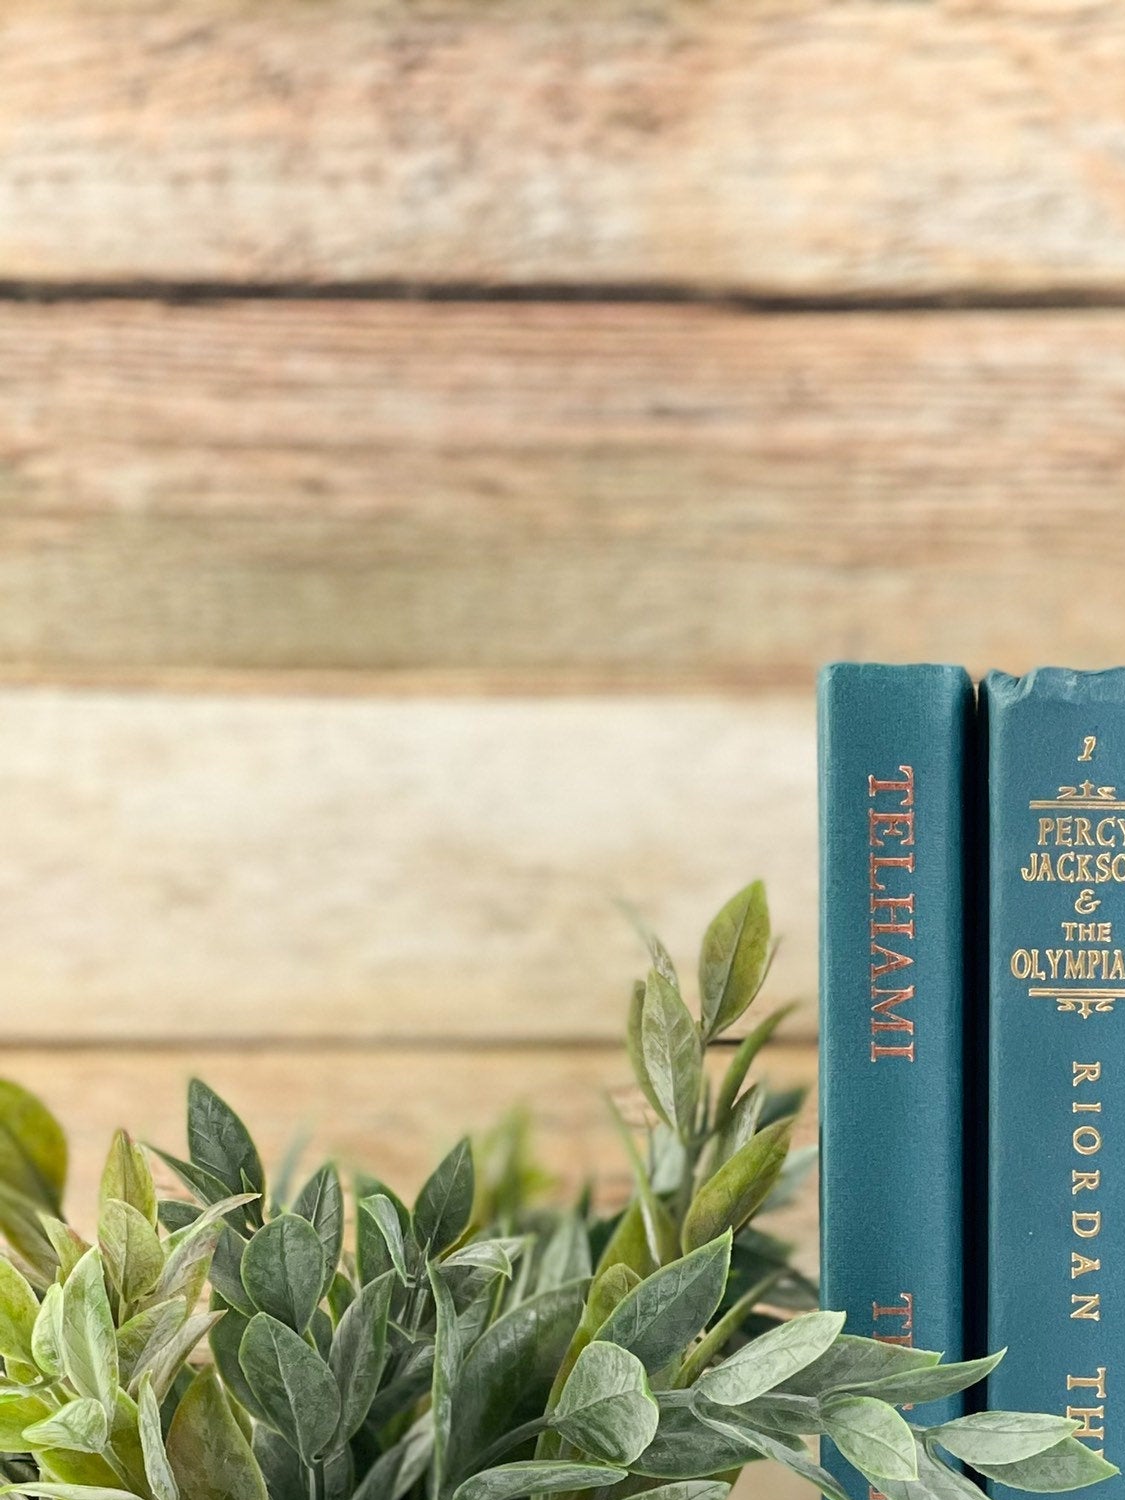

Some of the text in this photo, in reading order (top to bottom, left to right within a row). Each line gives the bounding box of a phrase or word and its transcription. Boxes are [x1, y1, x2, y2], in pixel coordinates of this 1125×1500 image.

[868, 765, 915, 1062] TELHAMI
[1062, 922, 1111, 942] THE
[1075, 889, 1101, 914] &
[1070, 1061, 1101, 1321] RIORDAN
[1066, 1367, 1106, 1458] TH
